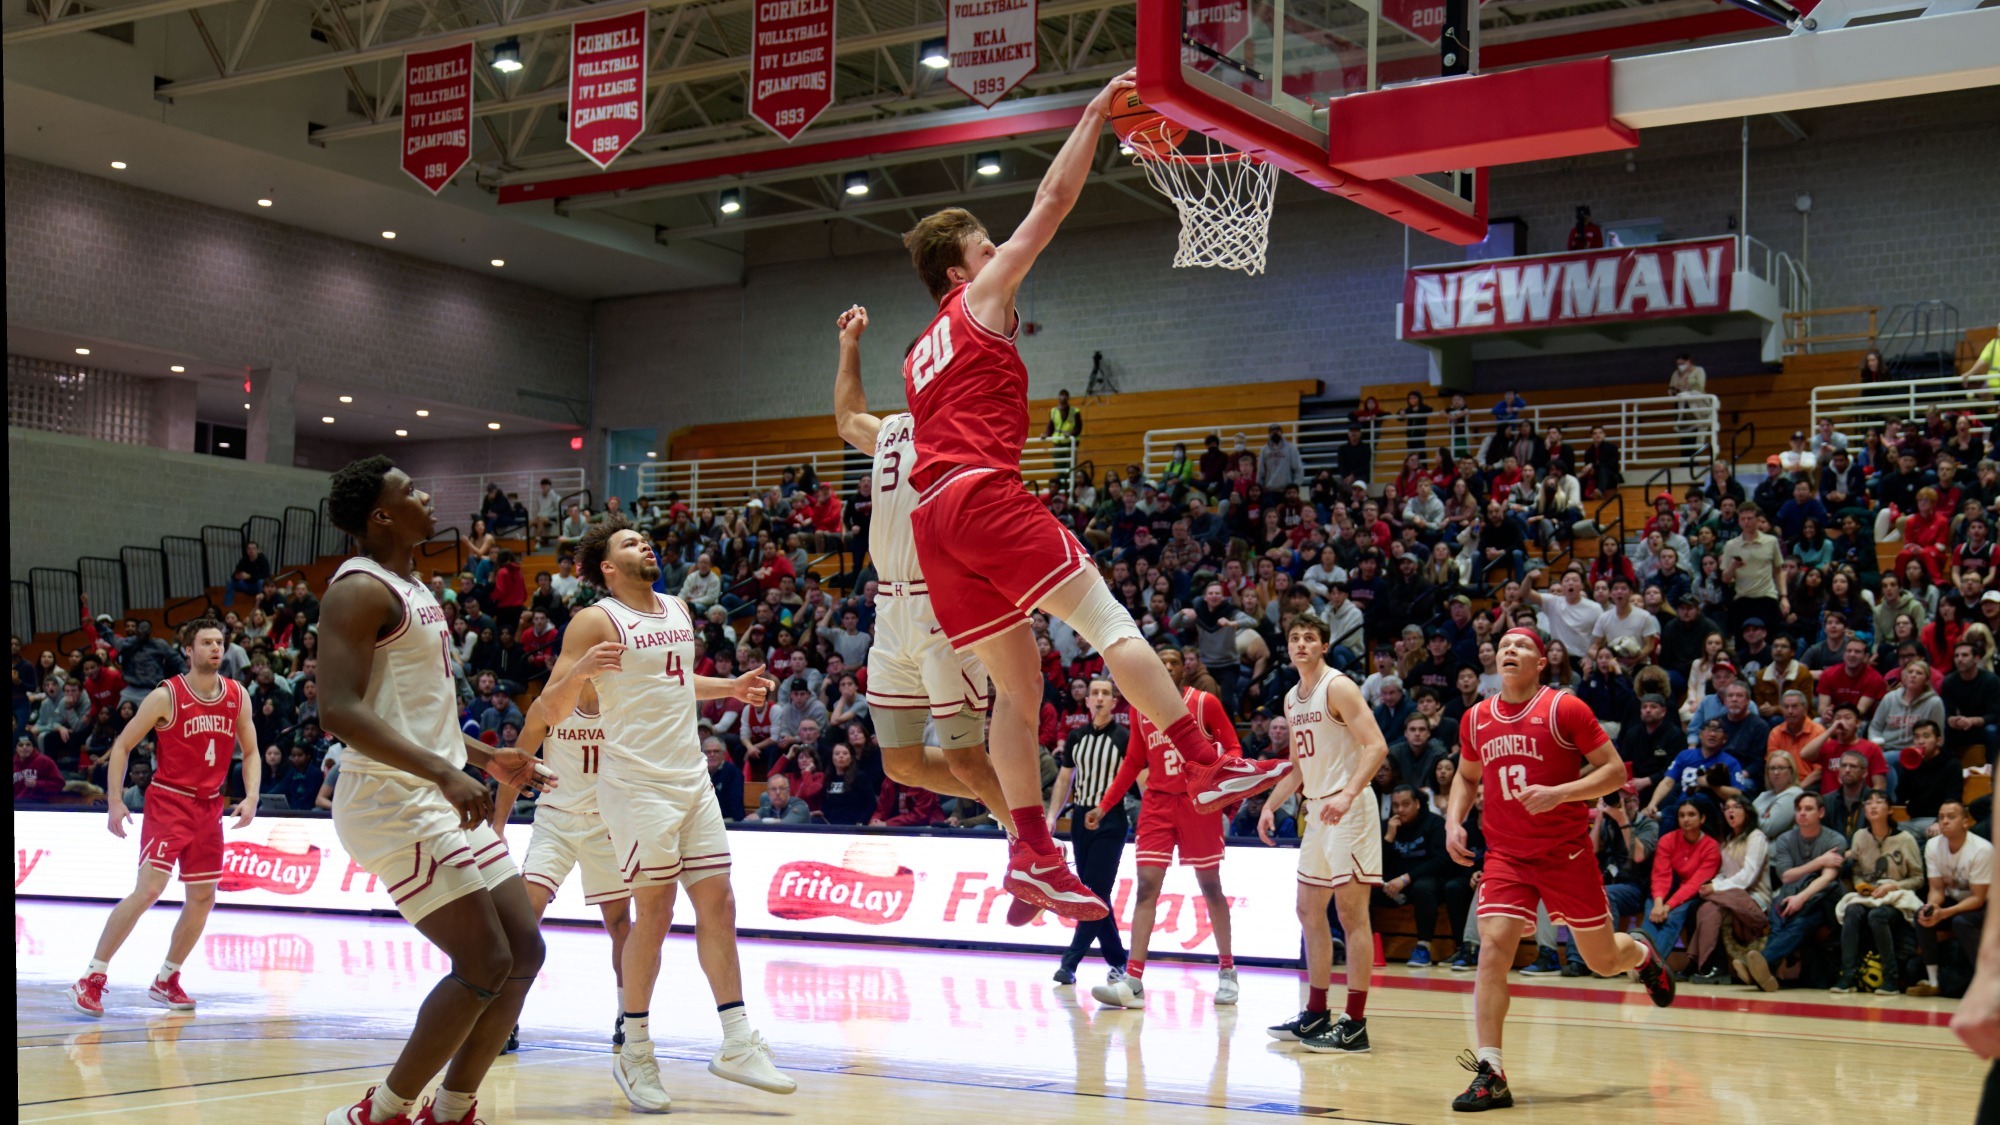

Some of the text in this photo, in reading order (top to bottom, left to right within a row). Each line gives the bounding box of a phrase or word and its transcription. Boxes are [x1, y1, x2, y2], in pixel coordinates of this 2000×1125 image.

[760, 0, 829, 23] CORNELL
[954, 0, 1028, 19] VOLLEYBALL
[1412, 6, 1447, 28] 200
[577, 27, 640, 55] CORNELL
[758, 22, 828, 47] VOLLEYBALL
[973, 31, 1007, 47] NCAA
[577, 54, 639, 78] VOLLEYBALL
[760, 47, 825, 71] IVY LEAGUE
[950, 42, 1033, 68] TOURNAMENT
[409, 58, 468, 86] CORNELL
[409, 84, 466, 106] VOLLEYBALL
[578, 77, 636, 100] IVY LEAGUE
[757, 70, 826, 101] CHAMPIONS
[973, 77, 1005, 95] 1993
[411, 107, 465, 128] IVY LEAGUE
[575, 101, 638, 129] CHAMPIONS
[774, 107, 805, 127] 1993
[407, 129, 466, 156] CHAMPIONS
[592, 135, 619, 154] 1992
[424, 162, 447, 179] 1991
[1411, 246, 1725, 332] NEWMAN
[912, 315, 954, 395] 20
[881, 451, 901, 493] 3
[634, 629, 694, 649] HARVARD
[665, 651, 685, 686] 4
[184, 715, 234, 738] CORNELL
[557, 728, 606, 741] HARVA
[204, 738, 216, 767] 4
[1296, 729, 1315, 758] 20
[1480, 734, 1544, 767] CORNELL
[581, 745, 599, 774] 11
[1498, 763, 1528, 801] 13
